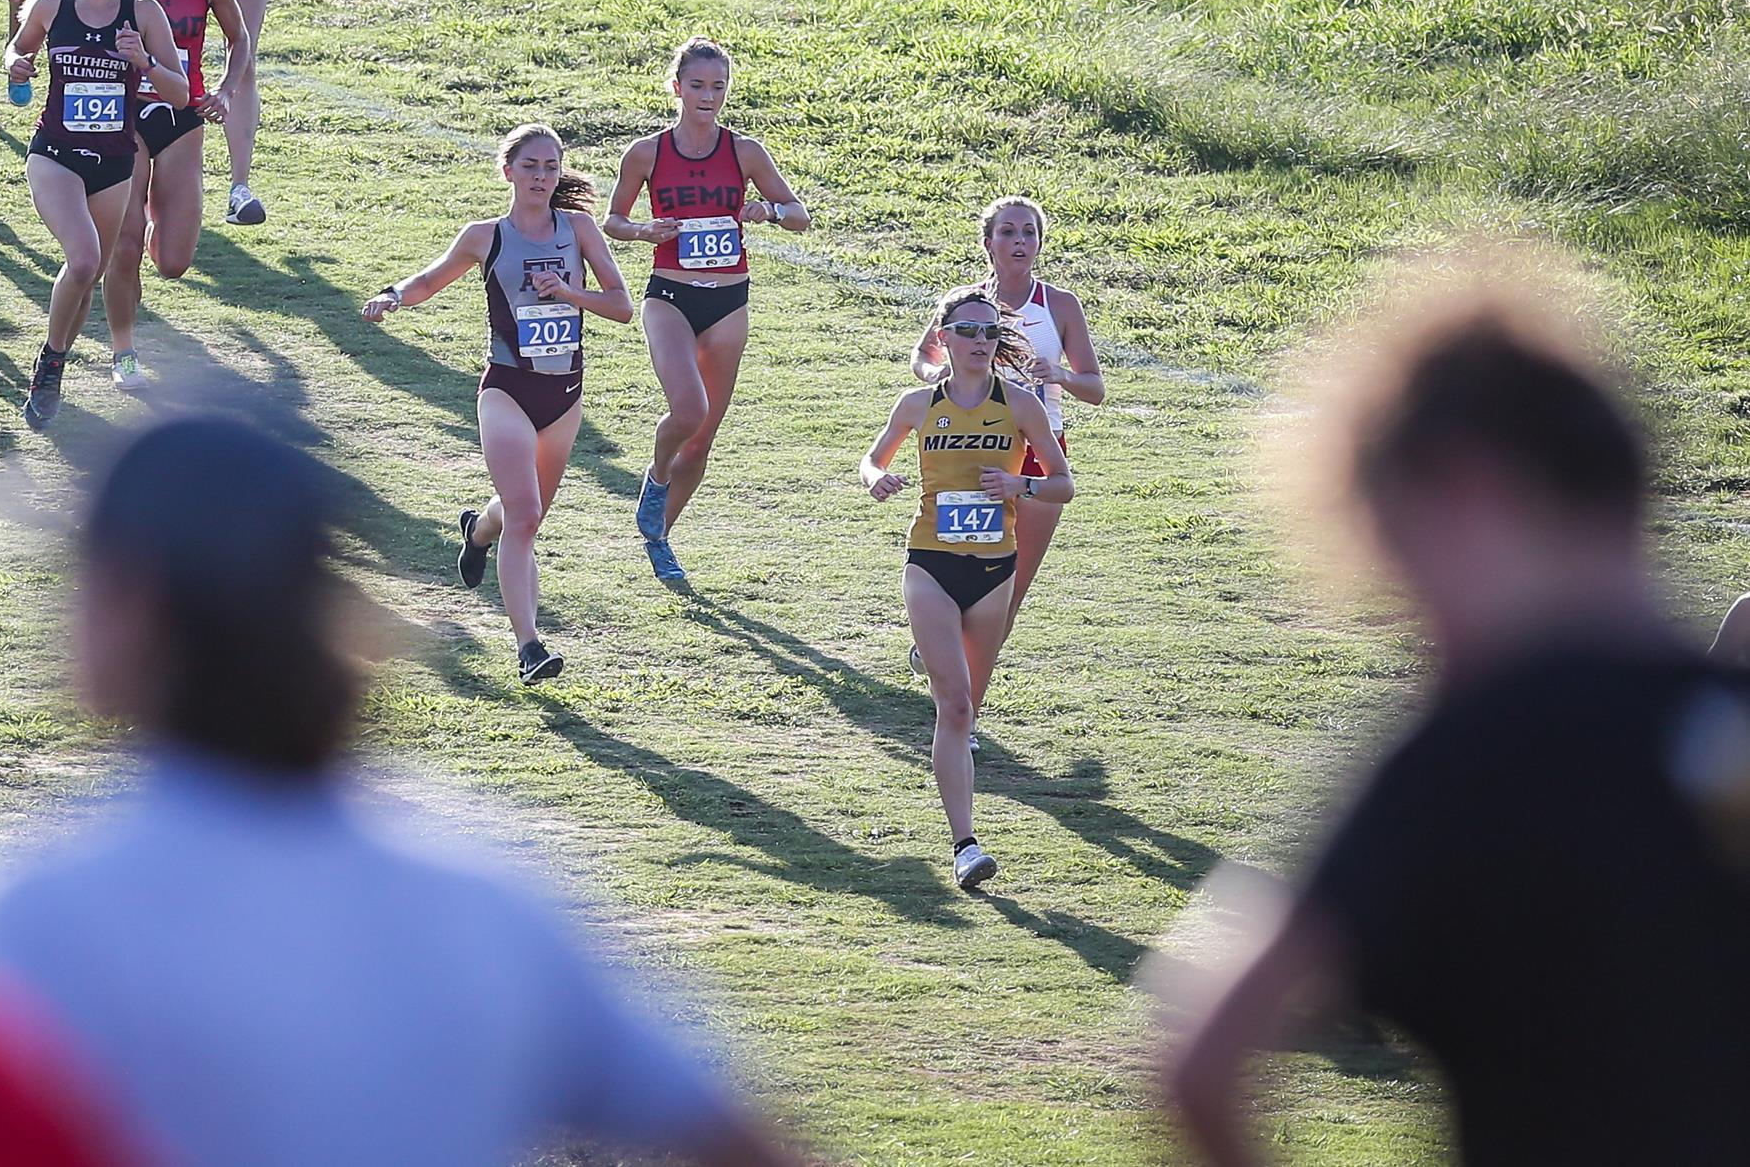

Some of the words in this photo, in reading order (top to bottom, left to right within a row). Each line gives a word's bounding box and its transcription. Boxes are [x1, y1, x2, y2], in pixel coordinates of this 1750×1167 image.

[55, 53, 129, 72] SOUTHERN
[62, 65, 118, 80] ILLINOIS
[73, 98, 118, 120] 194
[688, 232, 733, 257] 186
[528, 319, 572, 345] 202
[923, 434, 1013, 451] MIZZOU
[948, 507, 996, 531] 147
